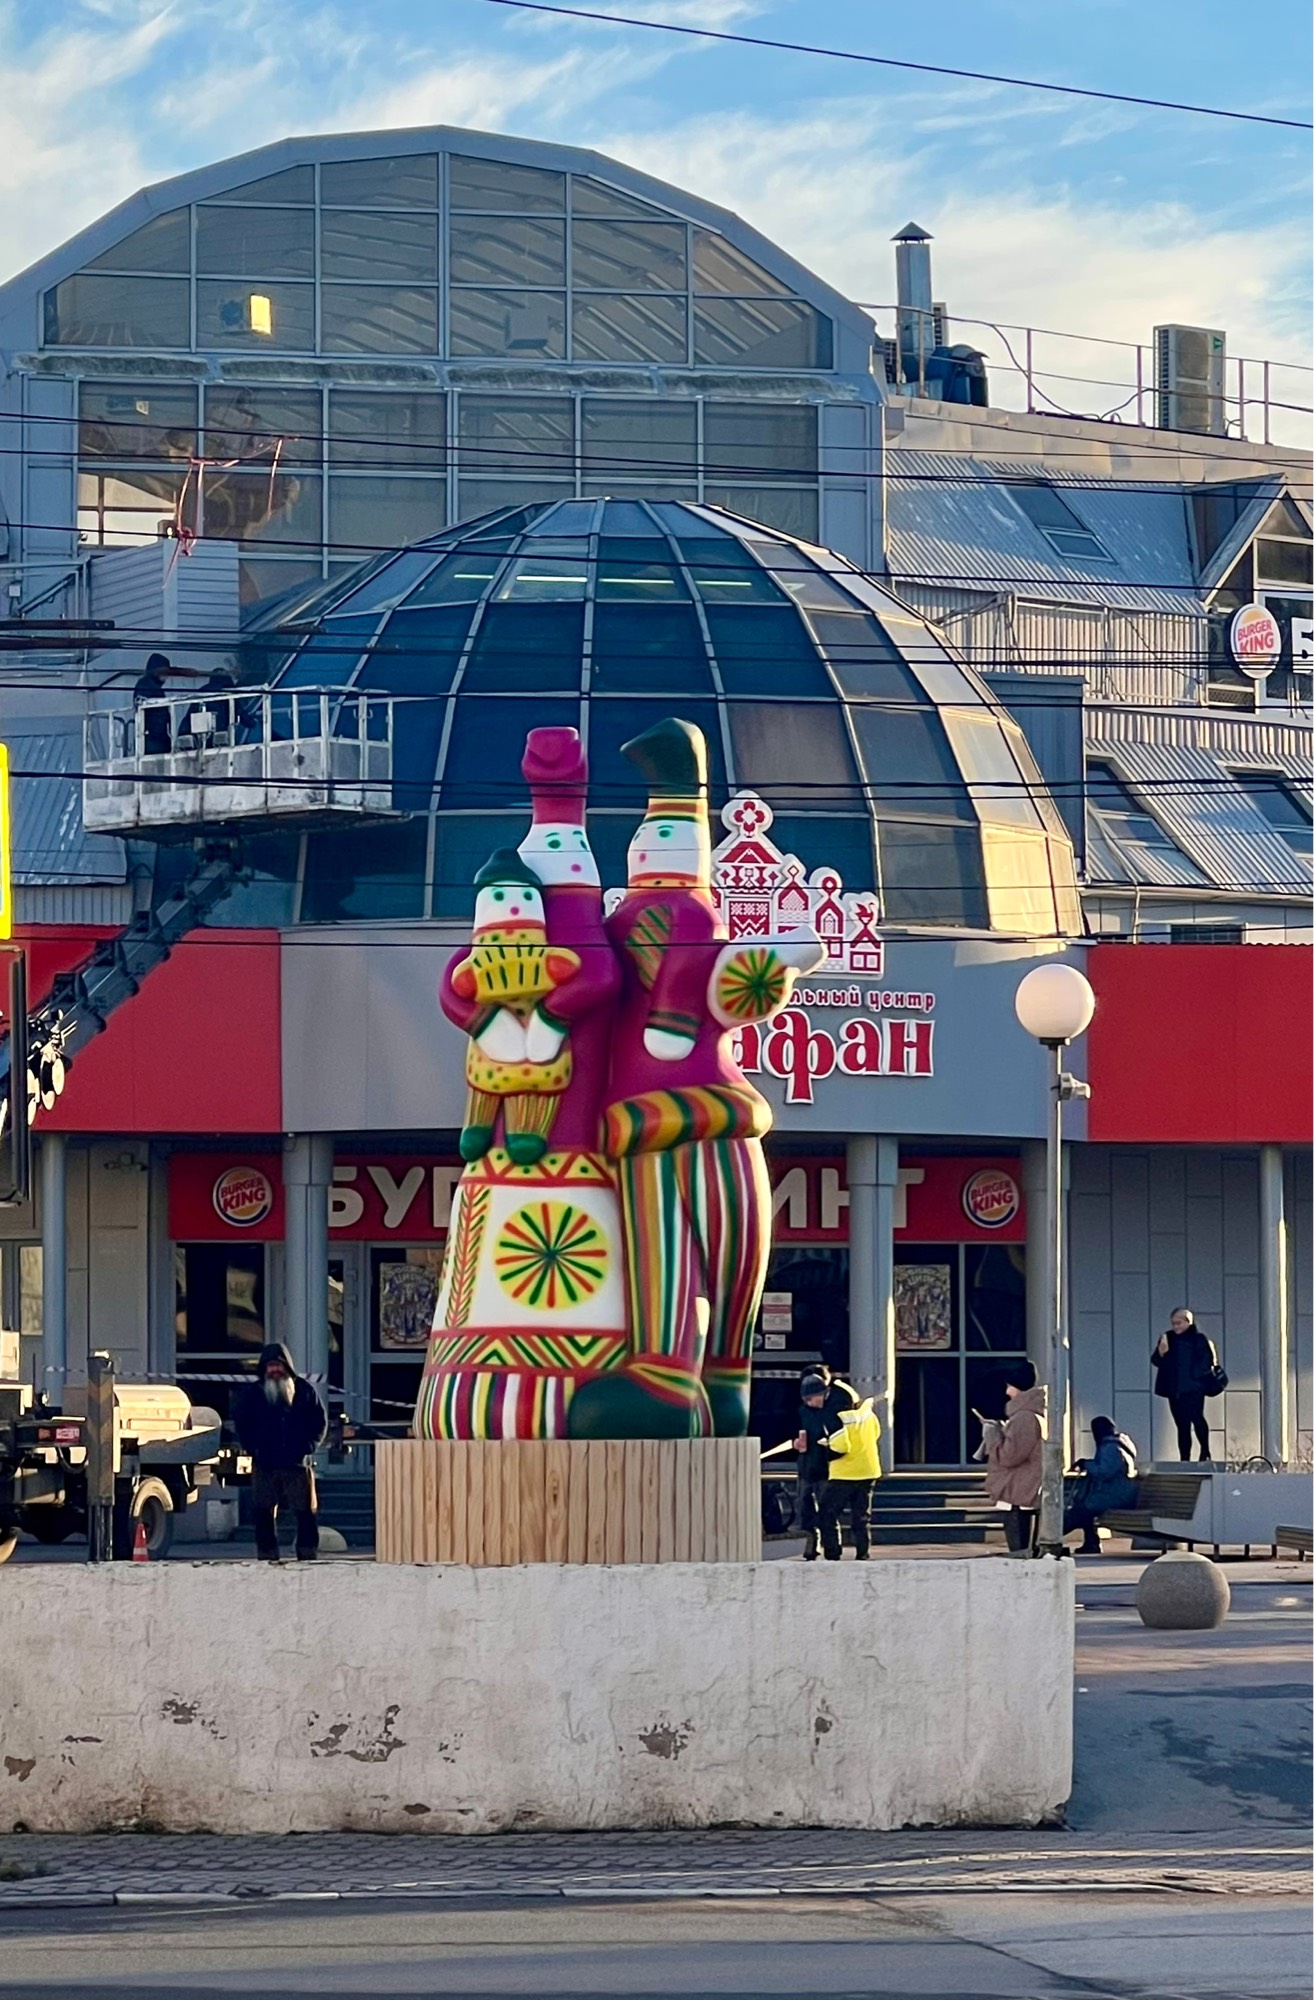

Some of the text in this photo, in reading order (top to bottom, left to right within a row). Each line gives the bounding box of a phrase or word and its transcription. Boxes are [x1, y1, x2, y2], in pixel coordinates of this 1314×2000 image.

[1237, 619, 1272, 641] BURGER
[1239, 632, 1274, 656] KING
[788, 984, 935, 1013] льный центр
[733, 1008, 935, 1104] афан
[220, 1176, 263, 1198] BURGER
[971, 1180, 1012, 1201] BURGER
[222, 1187, 266, 1212] KING
[973, 1190, 1014, 1213] KING
